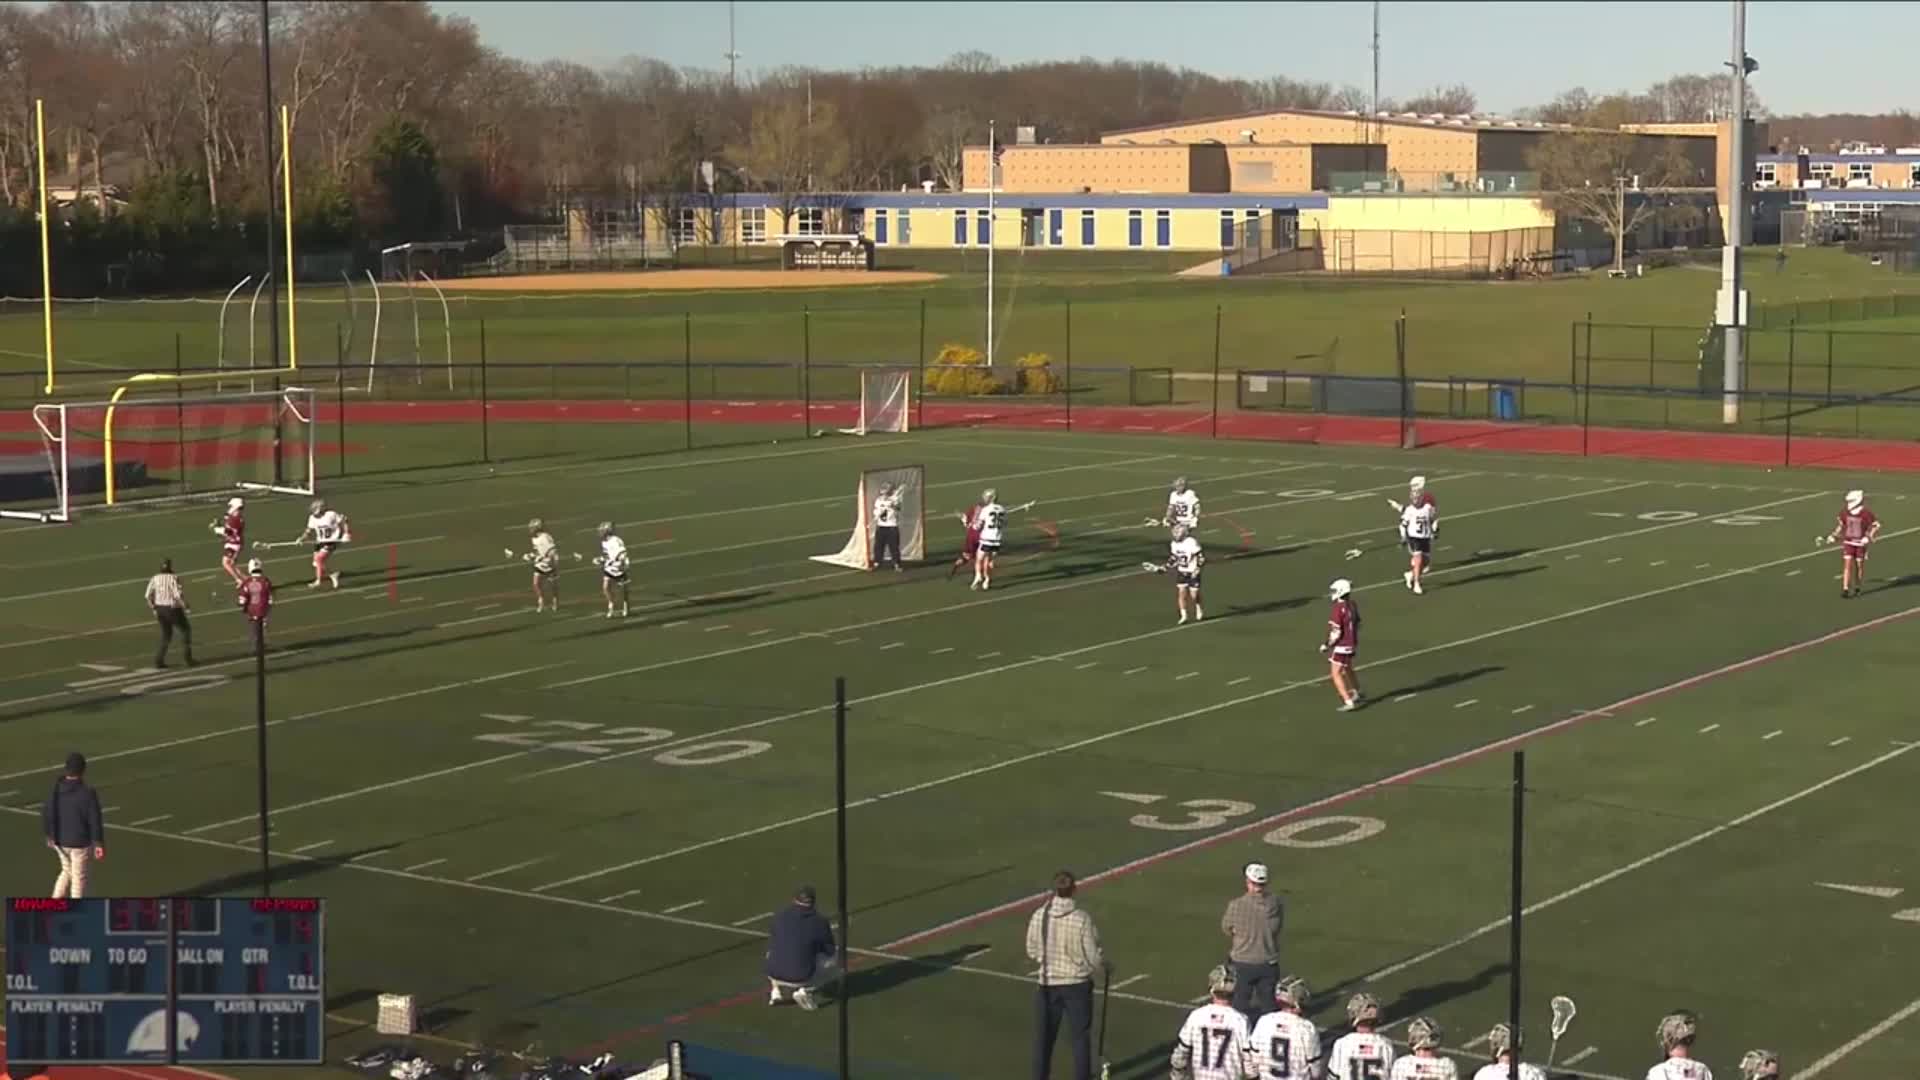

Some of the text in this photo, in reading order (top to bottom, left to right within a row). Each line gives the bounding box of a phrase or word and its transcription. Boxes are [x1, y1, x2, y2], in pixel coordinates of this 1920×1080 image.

[1130, 799, 1386, 849] 30
[1201, 1027, 1232, 1068] 17
[1271, 1037, 1290, 1077] 9
